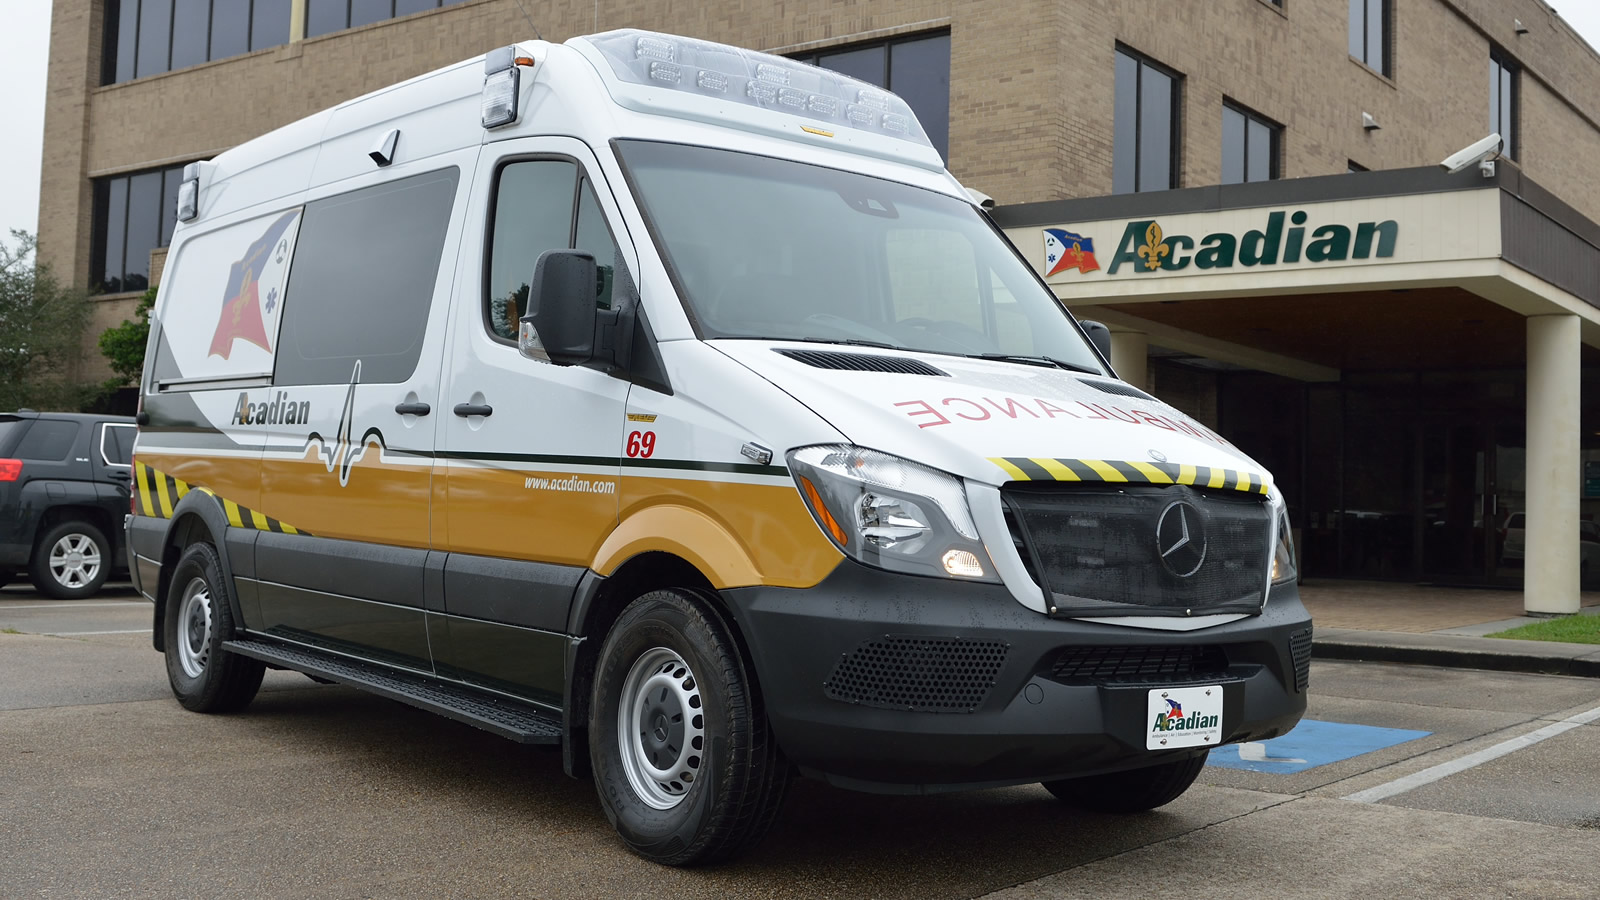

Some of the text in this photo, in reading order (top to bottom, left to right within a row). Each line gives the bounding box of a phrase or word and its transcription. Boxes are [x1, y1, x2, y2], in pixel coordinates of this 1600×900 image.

[1107, 210, 1398, 275] Acadian
[231, 390, 310, 426] Acadian
[626, 430, 656, 459] 69
[524, 475, 616, 495] www.acadian.com
[1152, 711, 1218, 732] Acadian
